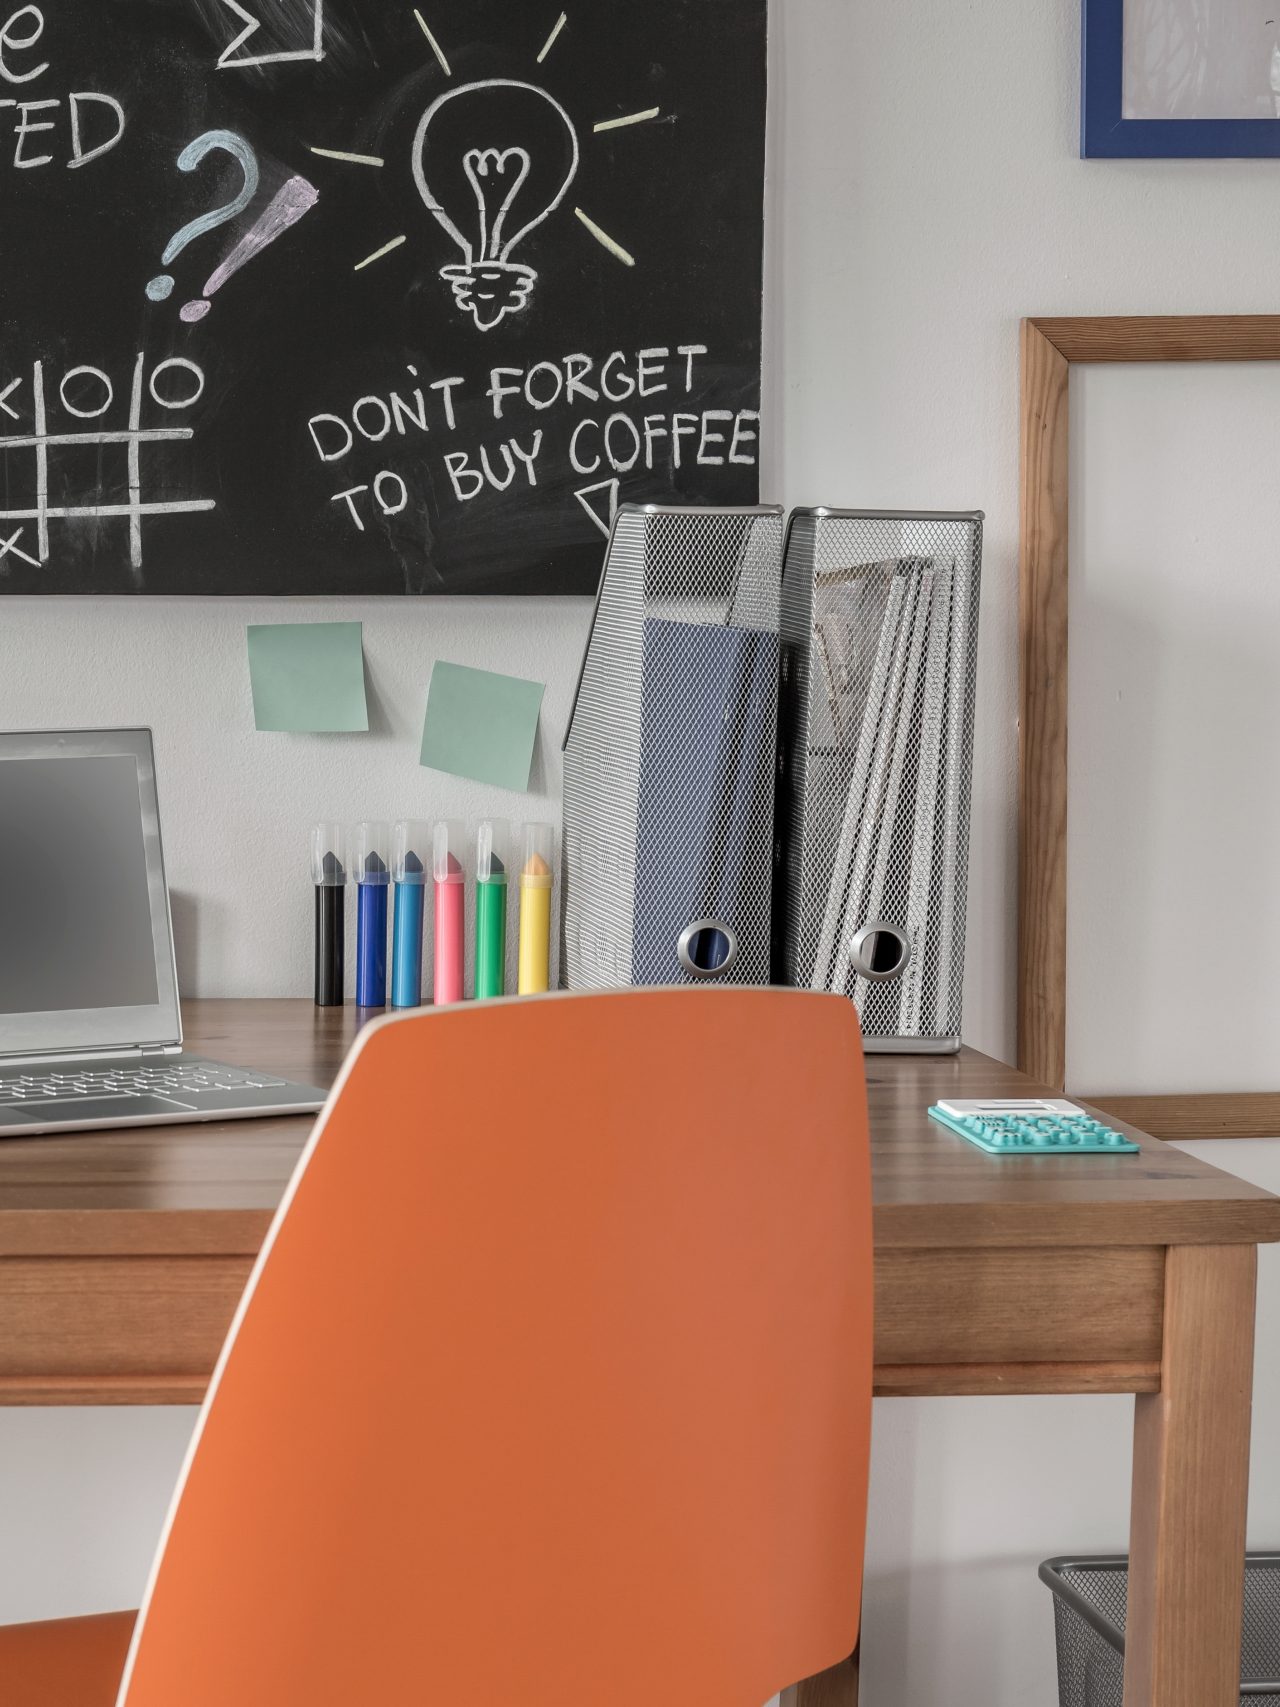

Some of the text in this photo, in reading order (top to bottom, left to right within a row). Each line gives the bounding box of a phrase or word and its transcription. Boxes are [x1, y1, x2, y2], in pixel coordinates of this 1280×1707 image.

[486, 344, 708, 419] FORGET
[331, 409, 760, 531] TO BUY COFFEE
